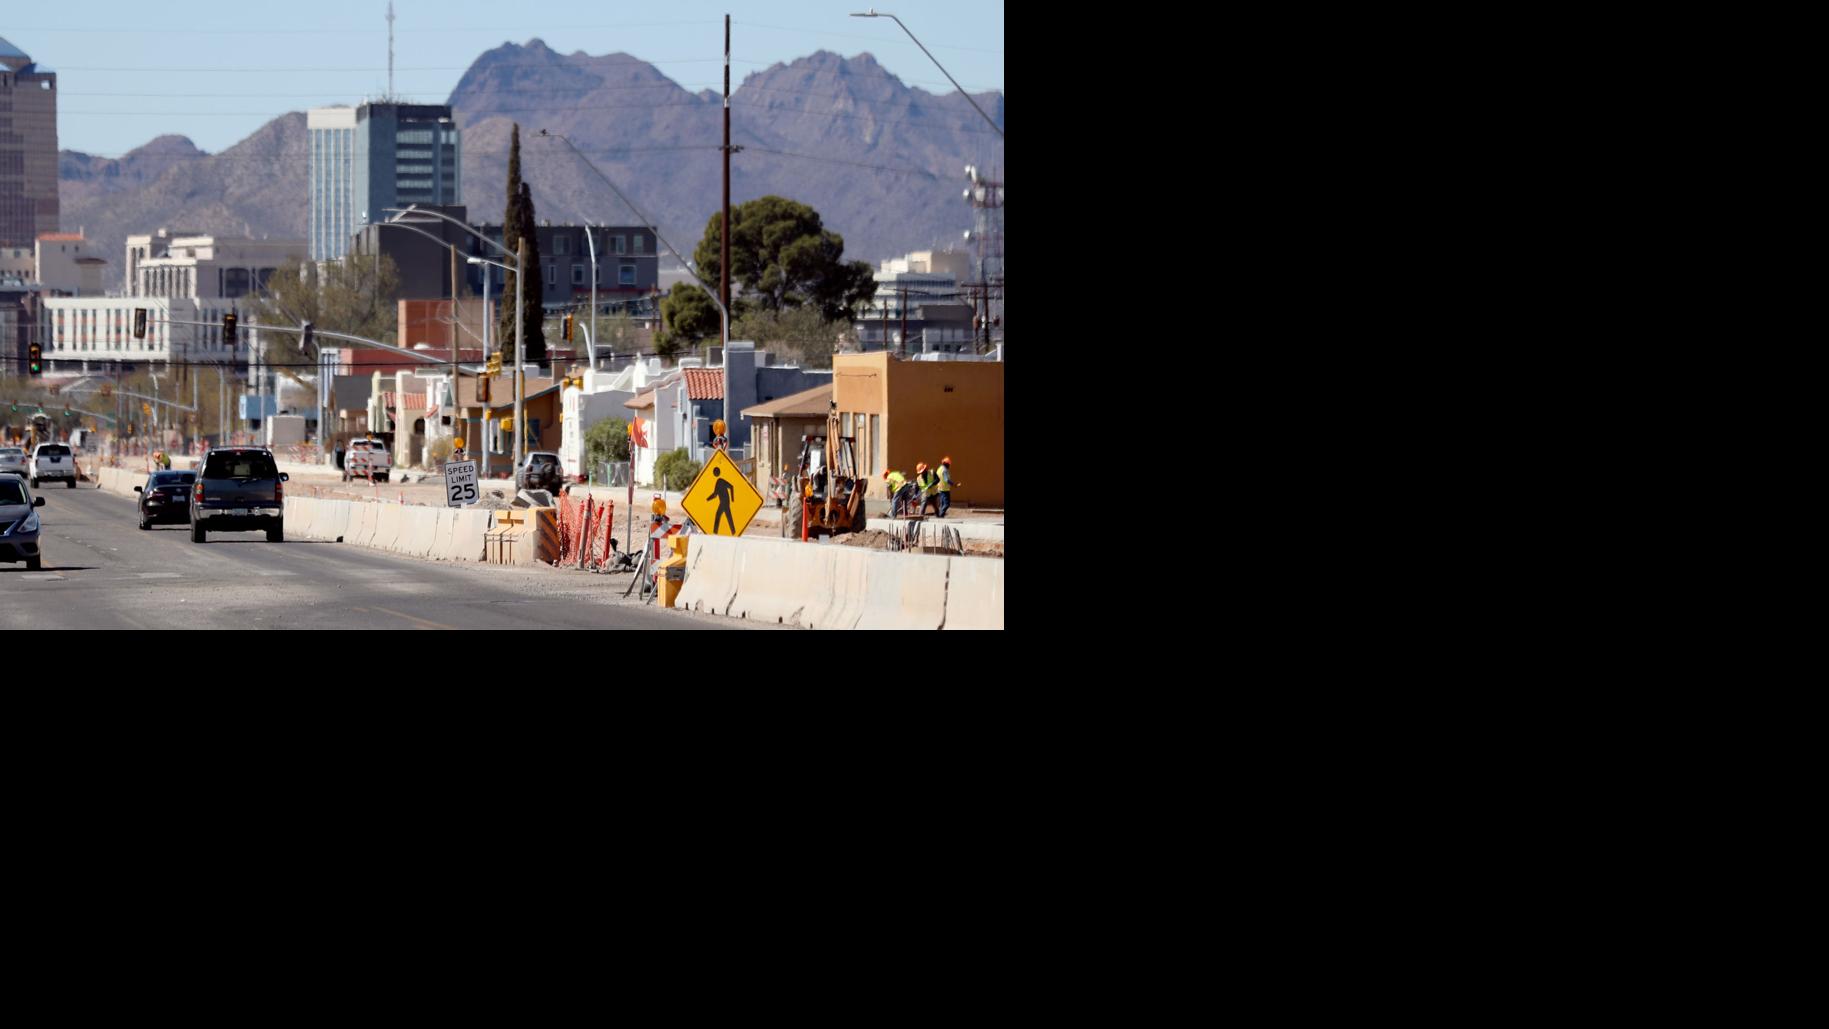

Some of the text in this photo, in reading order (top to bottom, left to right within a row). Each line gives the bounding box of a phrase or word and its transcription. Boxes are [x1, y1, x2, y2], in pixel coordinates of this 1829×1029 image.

[447, 465, 474, 475] SPEED
[451, 474, 471, 484] LIMIT
[450, 483, 476, 502] 25
